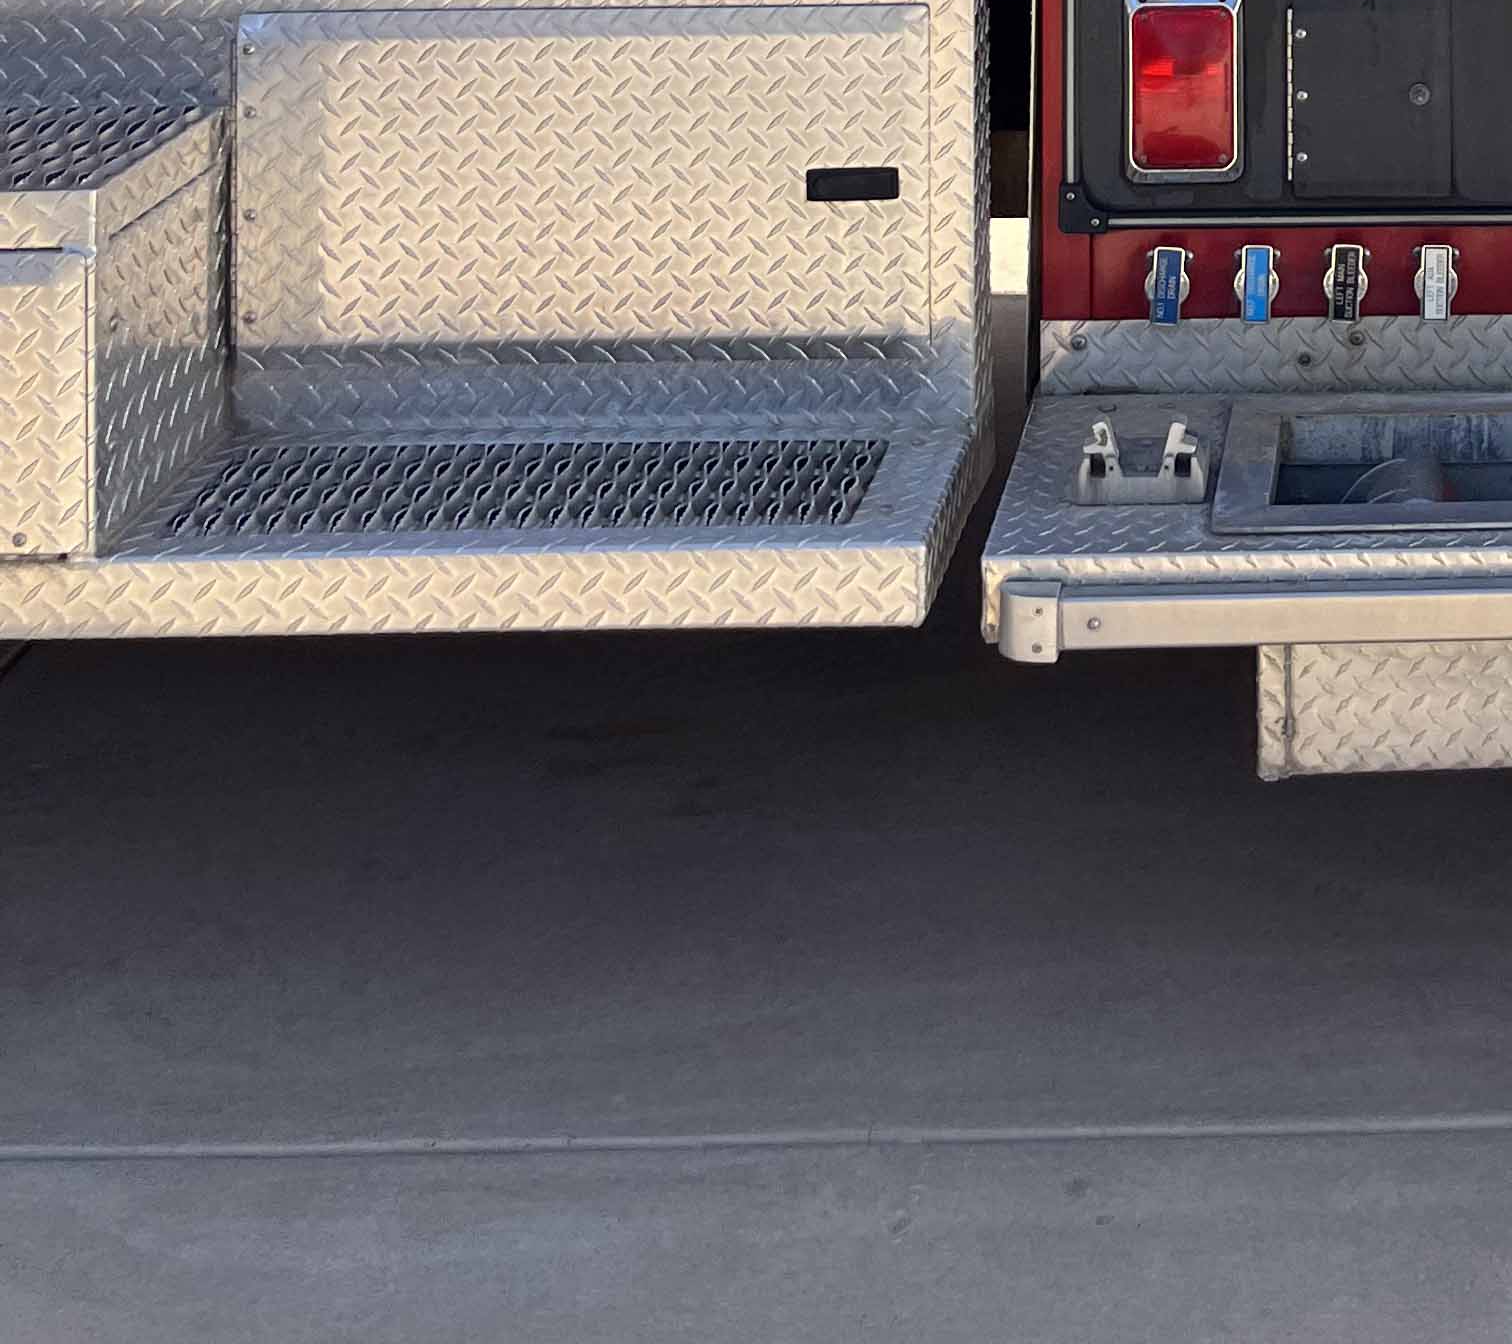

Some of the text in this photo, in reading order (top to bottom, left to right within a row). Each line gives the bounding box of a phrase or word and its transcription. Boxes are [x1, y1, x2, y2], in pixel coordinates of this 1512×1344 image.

[1336, 286, 1344, 305] LEFT
[1344, 251, 1356, 318] SUCTION BLEEDER
